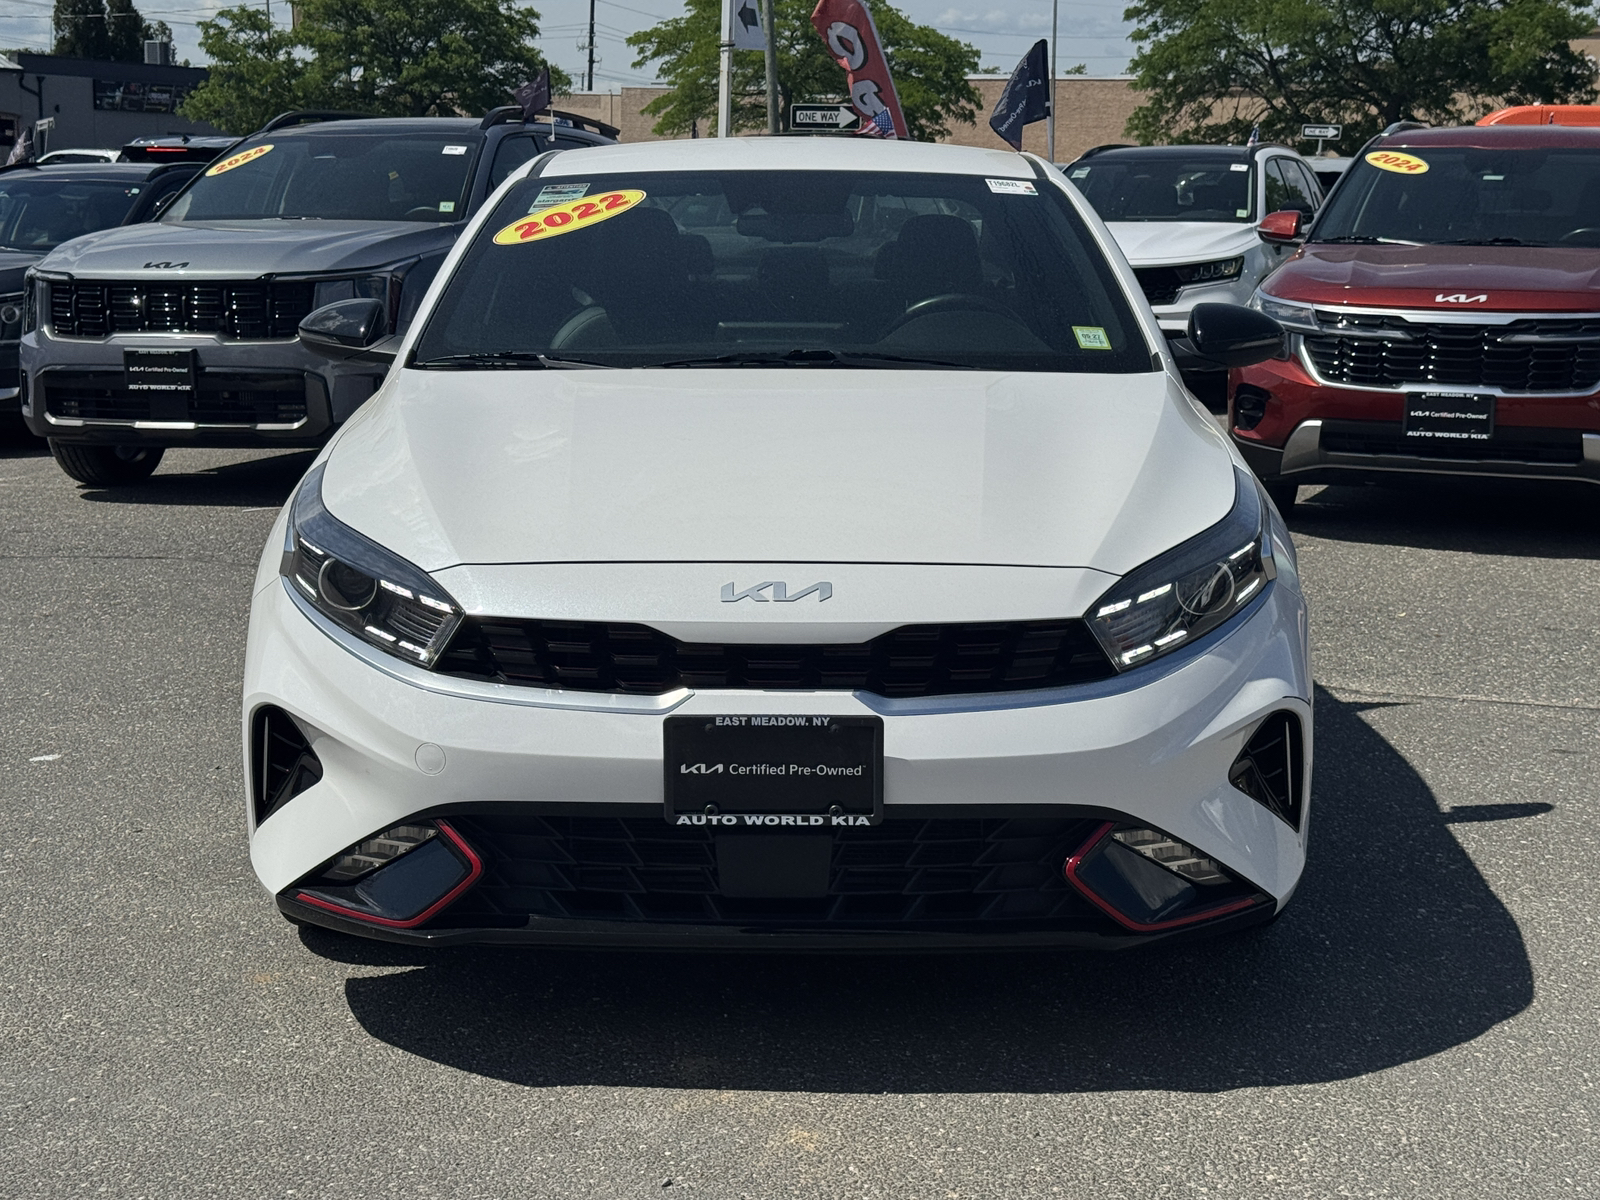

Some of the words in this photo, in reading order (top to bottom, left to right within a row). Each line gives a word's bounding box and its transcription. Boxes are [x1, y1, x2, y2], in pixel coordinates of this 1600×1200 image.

[798, 113, 817, 122] ONE
[820, 112, 840, 121] WAY
[215, 147, 266, 173] 2024
[1371, 153, 1423, 171] 2024
[515, 193, 631, 240] 2022
[1434, 293, 1488, 303] KIA
[1430, 411, 1455, 419] Certified
[1455, 412, 1488, 420] Pre-Owned
[720, 581, 832, 602] KIA
[715, 716, 747, 726] EAST
[813, 716, 831, 726] NY
[680, 763, 724, 774] KIA
[729, 763, 786, 775] Certified
[789, 764, 863, 776] Pre-Owned
[676, 815, 738, 825] AUTO
[744, 815, 824, 825] WORLD
[831, 815, 871, 826] KIA
